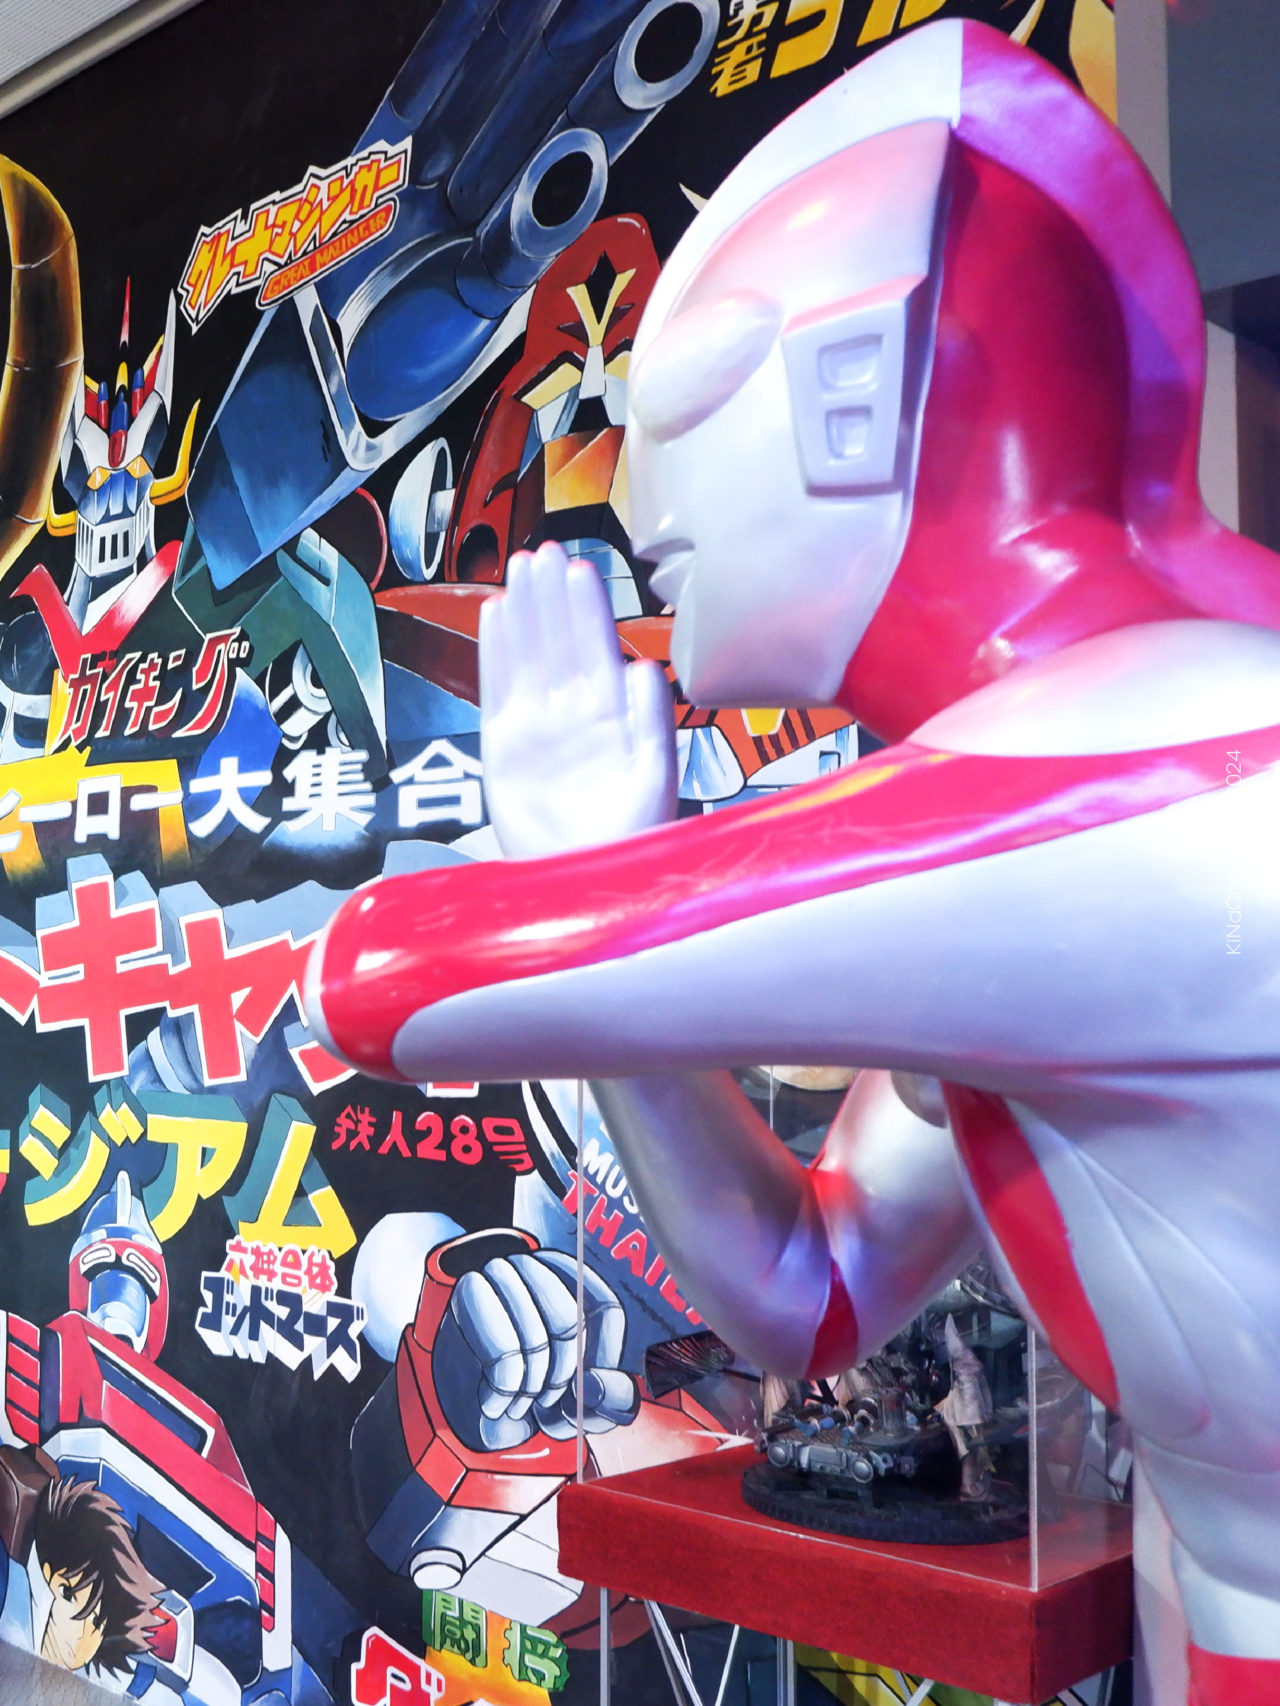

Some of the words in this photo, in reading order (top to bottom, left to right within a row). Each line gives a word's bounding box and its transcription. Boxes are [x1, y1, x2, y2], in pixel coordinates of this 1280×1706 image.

[44, 626, 251, 756] ガイキング
[331, 1104, 534, 1172] 鉄人28号
[196, 1273, 368, 1376] ゴッドマーズ
